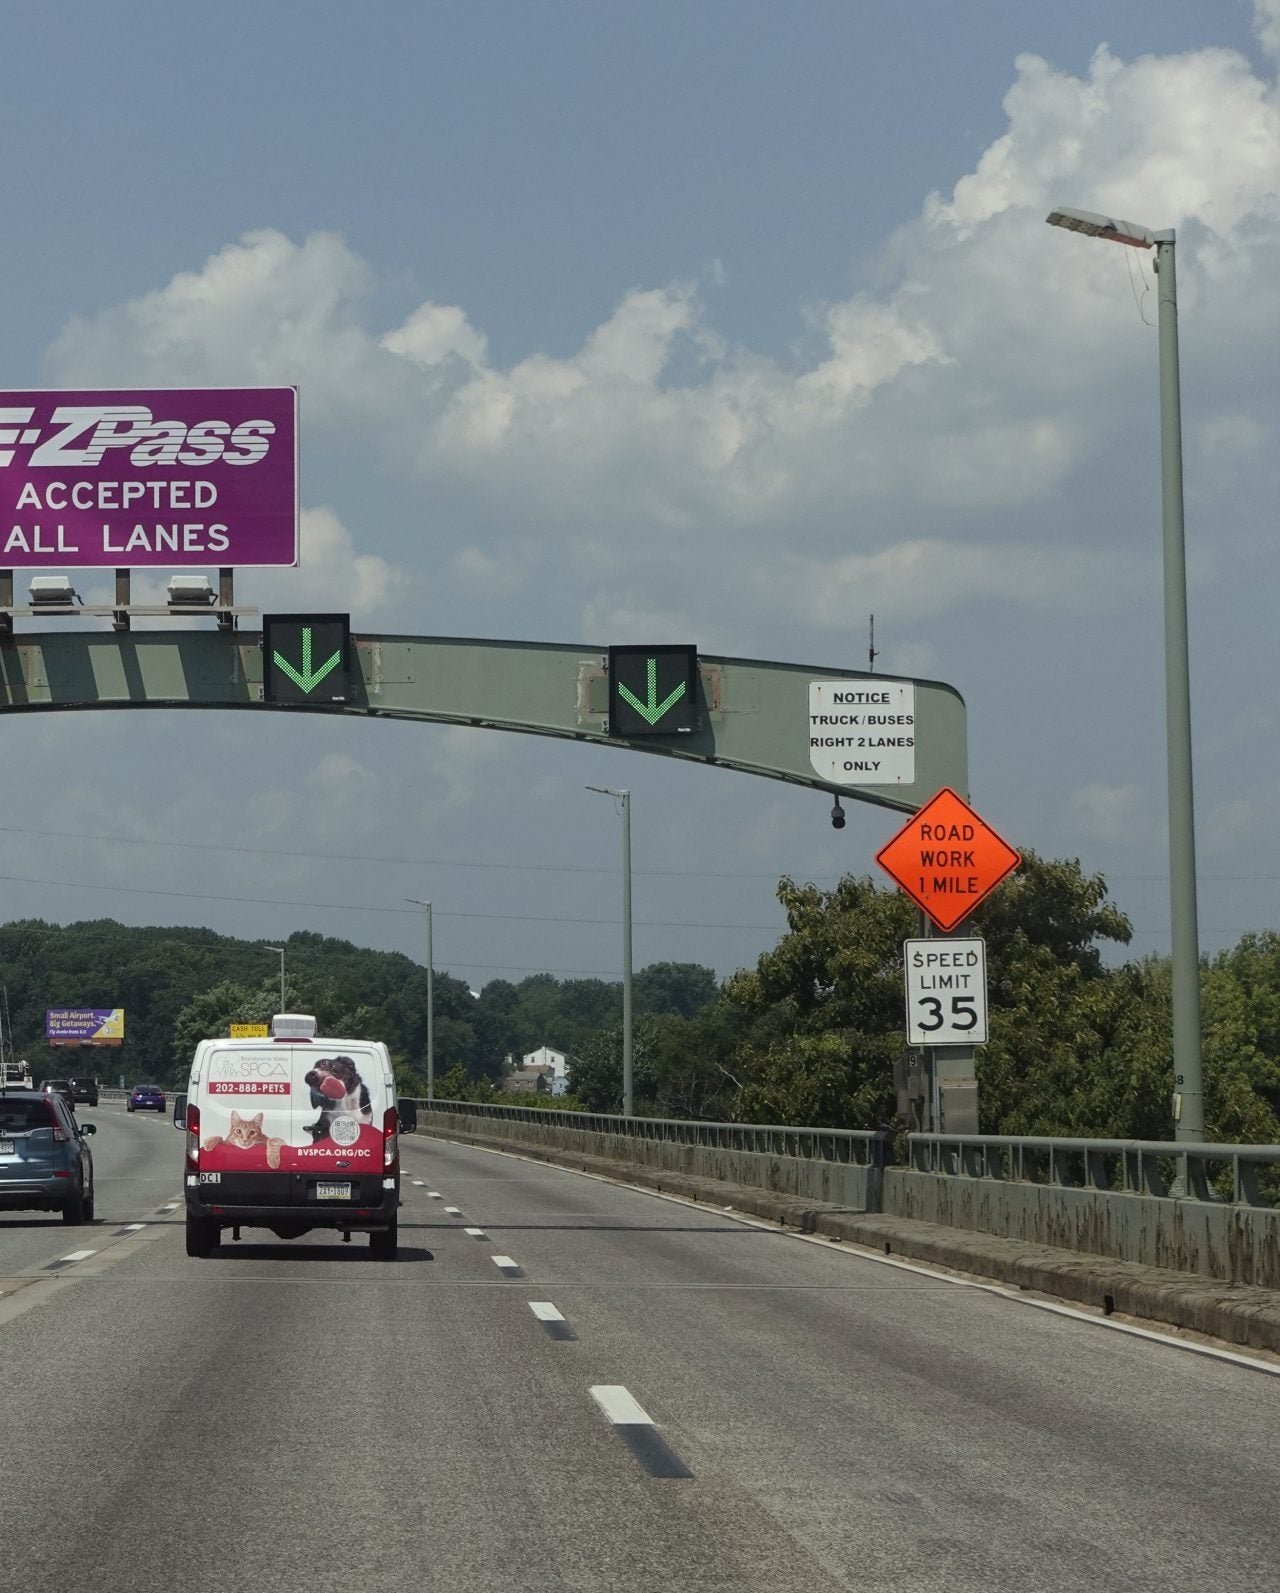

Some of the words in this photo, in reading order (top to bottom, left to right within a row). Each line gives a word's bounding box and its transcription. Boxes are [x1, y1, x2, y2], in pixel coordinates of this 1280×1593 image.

[15, 480, 218, 510] ACCEPTED
[3, 525, 79, 553] ALL
[103, 524, 230, 552] LANES
[833, 692, 891, 703] NOTICE
[810, 737, 854, 748] RIGHT
[857, 737, 865, 748] 2
[868, 737, 914, 748] LANES
[843, 761, 881, 771] ONLY
[920, 824, 974, 841] ROAD
[920, 850, 975, 868] WORK
[919, 876, 925, 894] 1
[933, 876, 979, 894] MILE
[912, 952, 978, 968] SPEED
[921, 974, 971, 990] LIMIT
[70, 1012, 96, 1020] Airport.
[917, 996, 978, 1031] 35
[50, 1020, 61, 1028] Big
[240, 1062, 288, 1078] SPCA
[215, 1083, 285, 1093] 202-888-PETS
[297, 1148, 371, 1157] BVSPCA.ORG/DC
